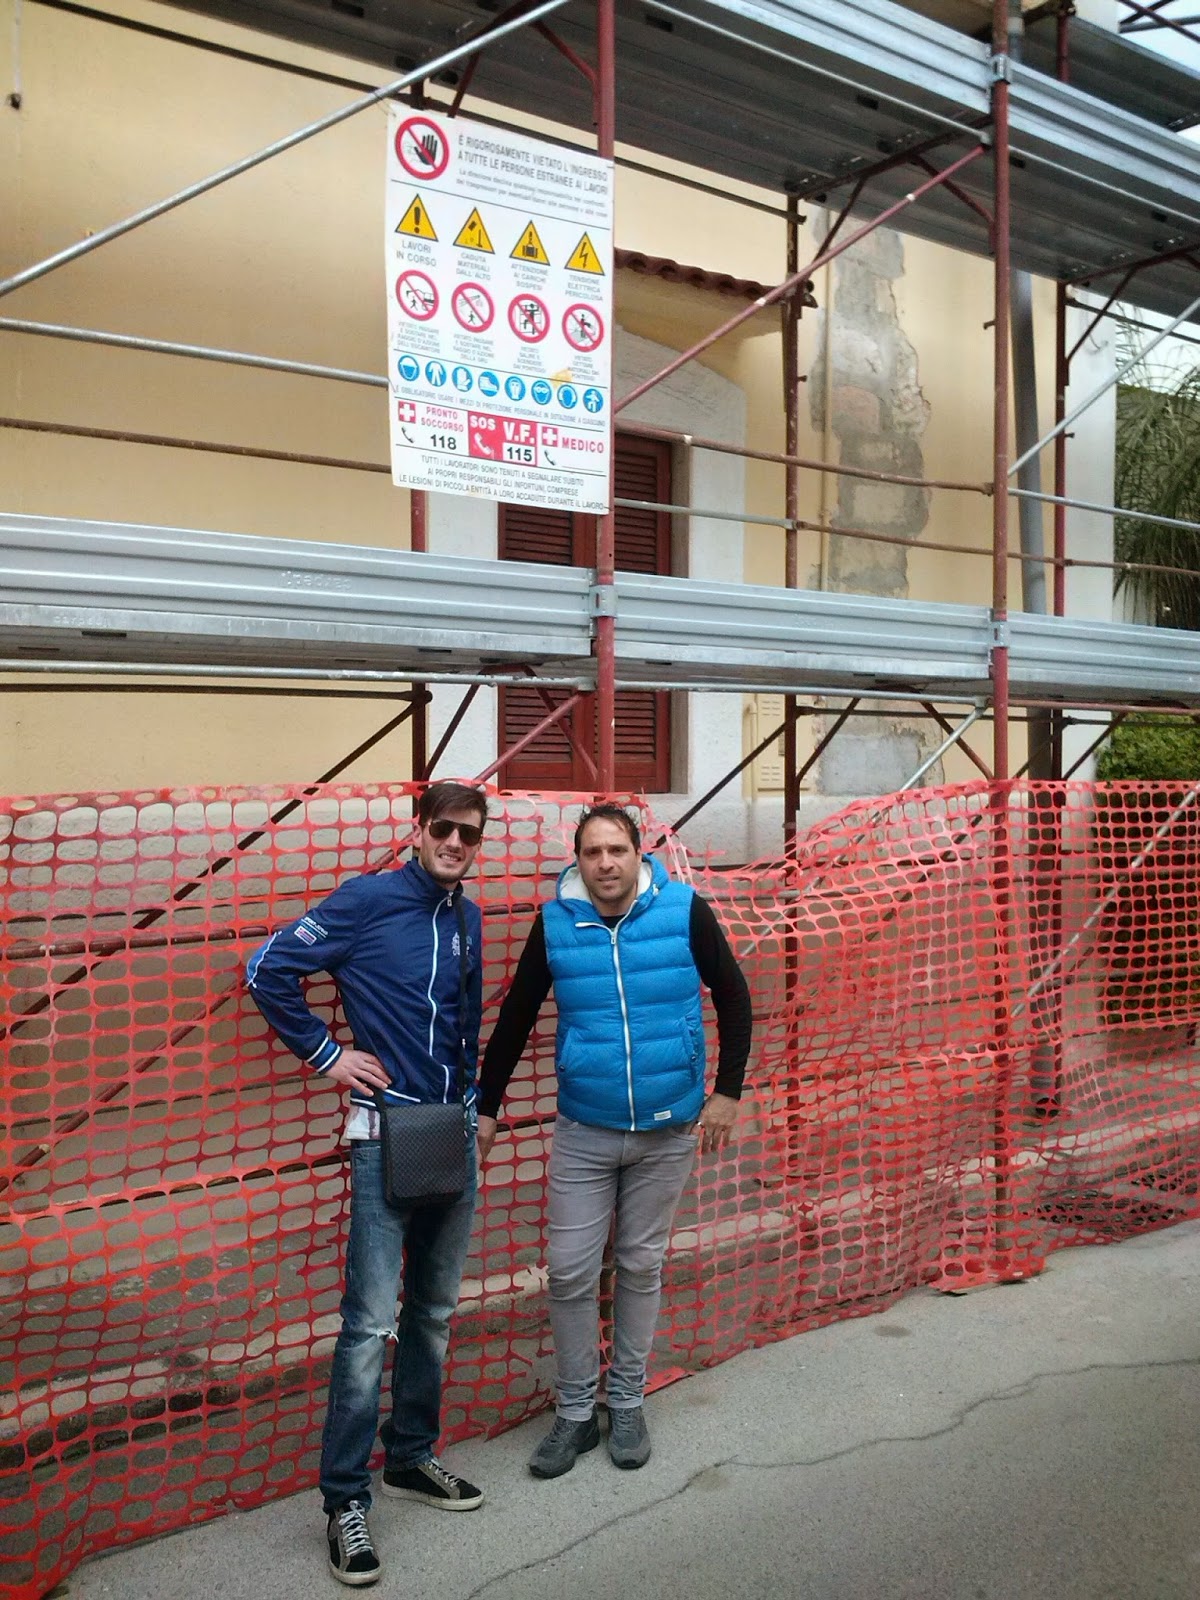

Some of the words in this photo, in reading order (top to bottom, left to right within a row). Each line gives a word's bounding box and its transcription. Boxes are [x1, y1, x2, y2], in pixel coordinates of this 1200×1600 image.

[467, 138, 530, 162] RIGOROSAMENTE
[533, 155, 562, 170] VIETATO
[458, 151, 463, 160] A
[464, 152, 488, 166] TUTTE
[490, 159, 499, 169] LE
[501, 161, 535, 178] PERSONE
[536, 170, 573, 187] ESTRANEE
[575, 180, 581, 189] AI
[584, 182, 607, 196] LAVORI
[401, 240, 431, 254] LAVORI
[396, 250, 404, 259] IN
[407, 253, 437, 267] CORSO
[461, 252, 486, 263] CADUTA
[567, 281, 600, 295] ELETTRICA
[569, 274, 599, 286] TENSIONE
[426, 406, 458, 420] PRONTO
[421, 417, 464, 432] SOCCORSO
[470, 415, 496, 431] SOS
[503, 421, 535, 444] V.F.
[430, 434, 456, 450] 118
[562, 437, 604, 453] MEDICO
[507, 446, 532, 462] 115
[421, 455, 439, 465] TUTTI
[444, 459, 479, 471] LAVORATORI
[481, 465, 497, 474] SONO
[499, 467, 520, 477] TENUTI
[527, 471, 561, 483] SEGNALARE
[562, 477, 584, 486] SUBITO
[435, 469, 457, 478] PROPRI
[459, 472, 501, 485] RESPONSABILI
[503, 479, 512, 487] GLI
[546, 485, 578, 496] COMPRESE
[399, 474, 406, 482] LE
[408, 475, 434, 486] LESIONI
[443, 481, 469, 491] PICCOLA
[499, 489, 514, 498] LORO
[516, 492, 546, 502] ACCADUTE
[547, 496, 574, 506] DURANTE
[582, 501, 603, 510] LAVORO
